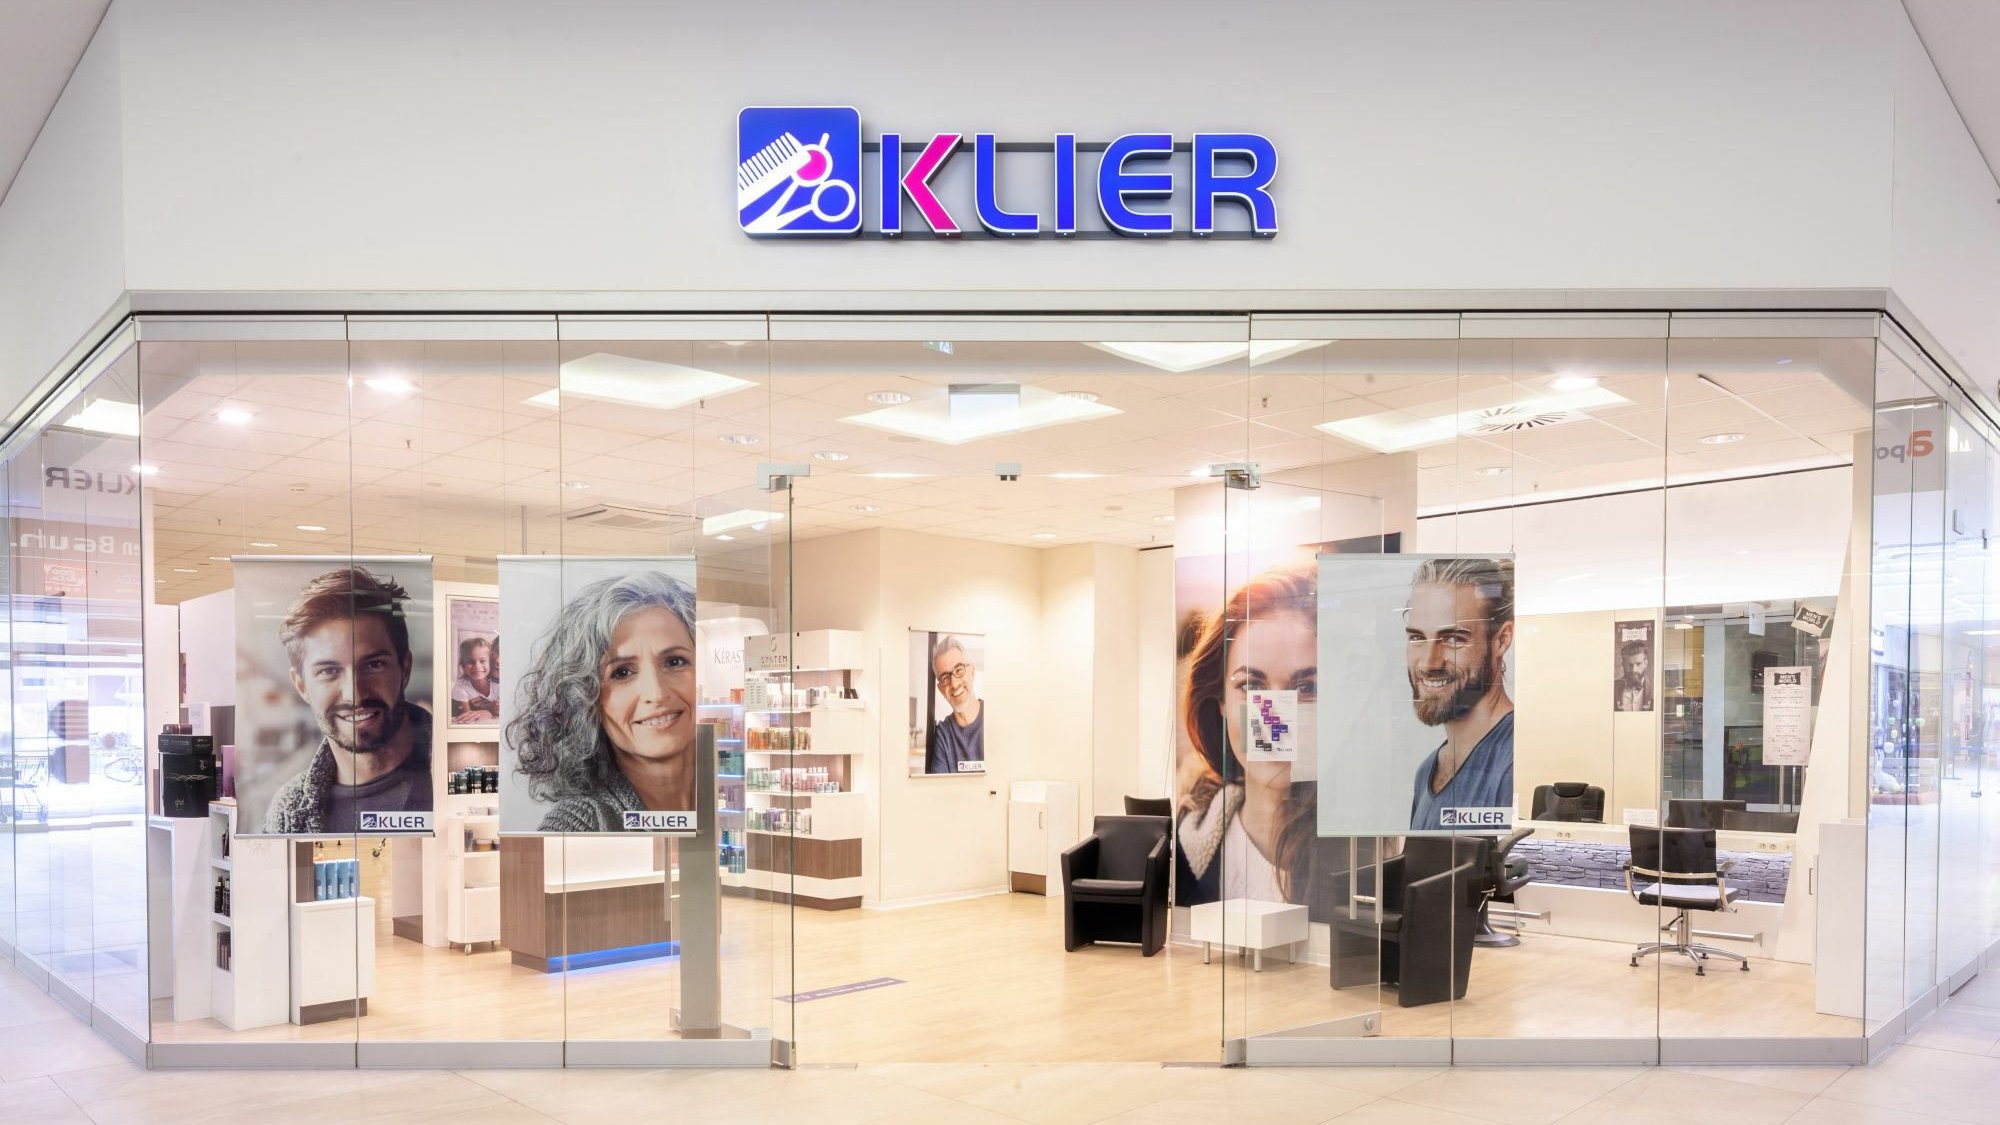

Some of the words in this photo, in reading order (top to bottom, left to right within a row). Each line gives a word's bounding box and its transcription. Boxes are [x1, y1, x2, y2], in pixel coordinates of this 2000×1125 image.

[880, 132, 1279, 235] KLIER
[379, 816, 425, 828] KLIER
[642, 815, 688, 827] KLIER
[1458, 811, 1504, 824] KLIER
